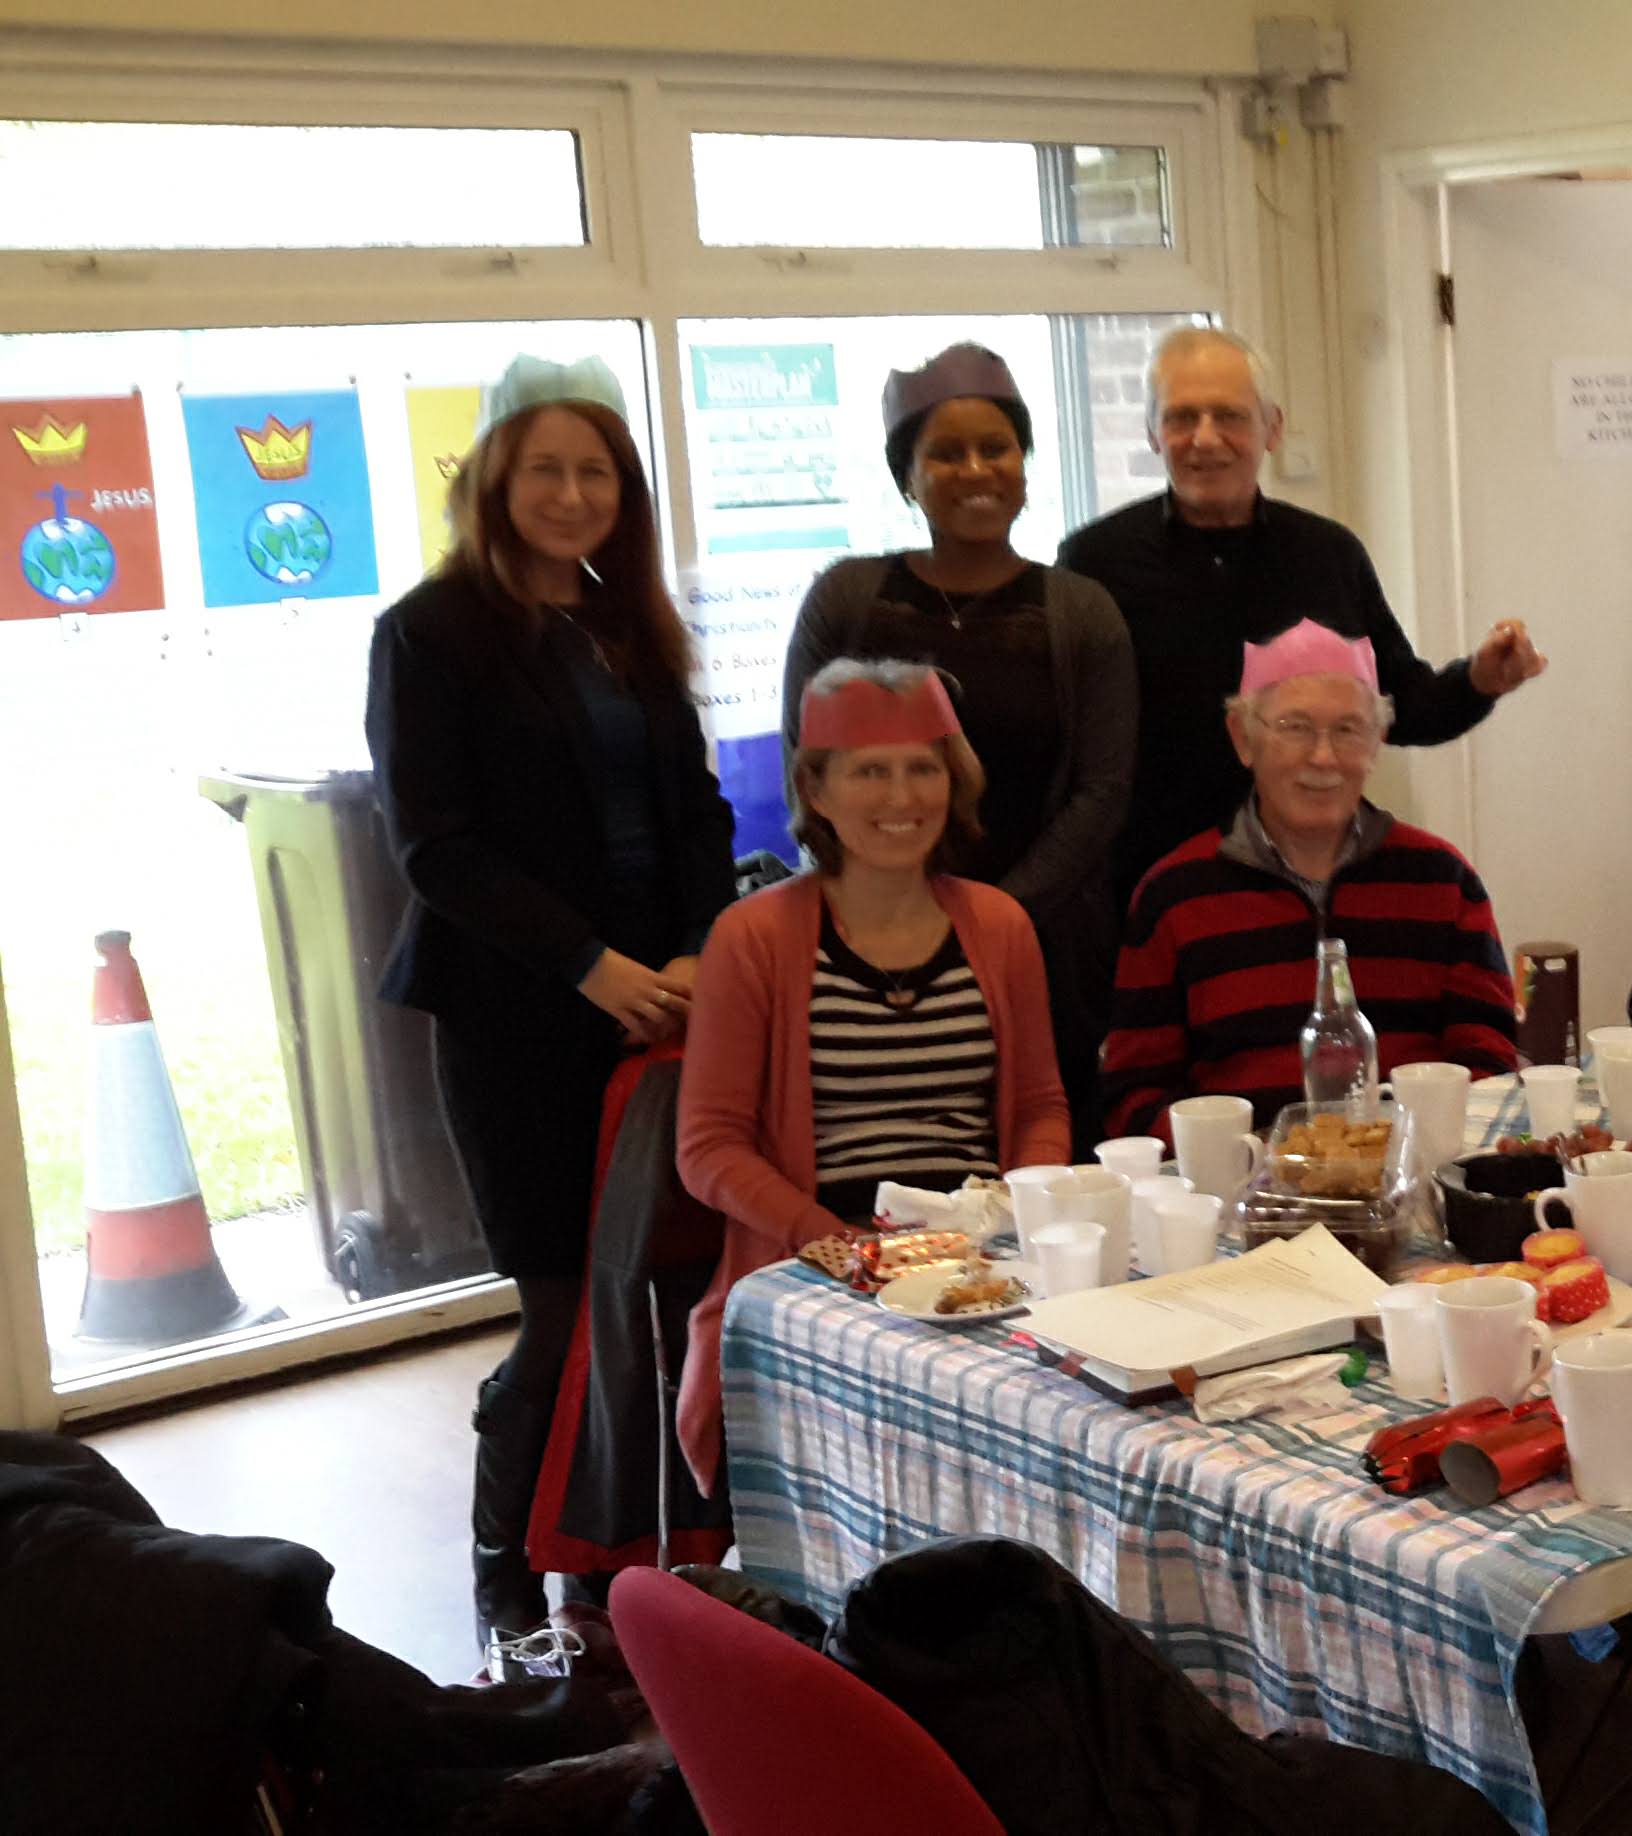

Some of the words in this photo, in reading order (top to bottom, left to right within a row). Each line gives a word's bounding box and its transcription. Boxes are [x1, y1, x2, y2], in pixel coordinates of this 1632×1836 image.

[1570, 392, 1597, 406] ARE
[91, 487, 153, 511] JESUS
[688, 585, 733, 604] Good
[741, 584, 781, 600] News
